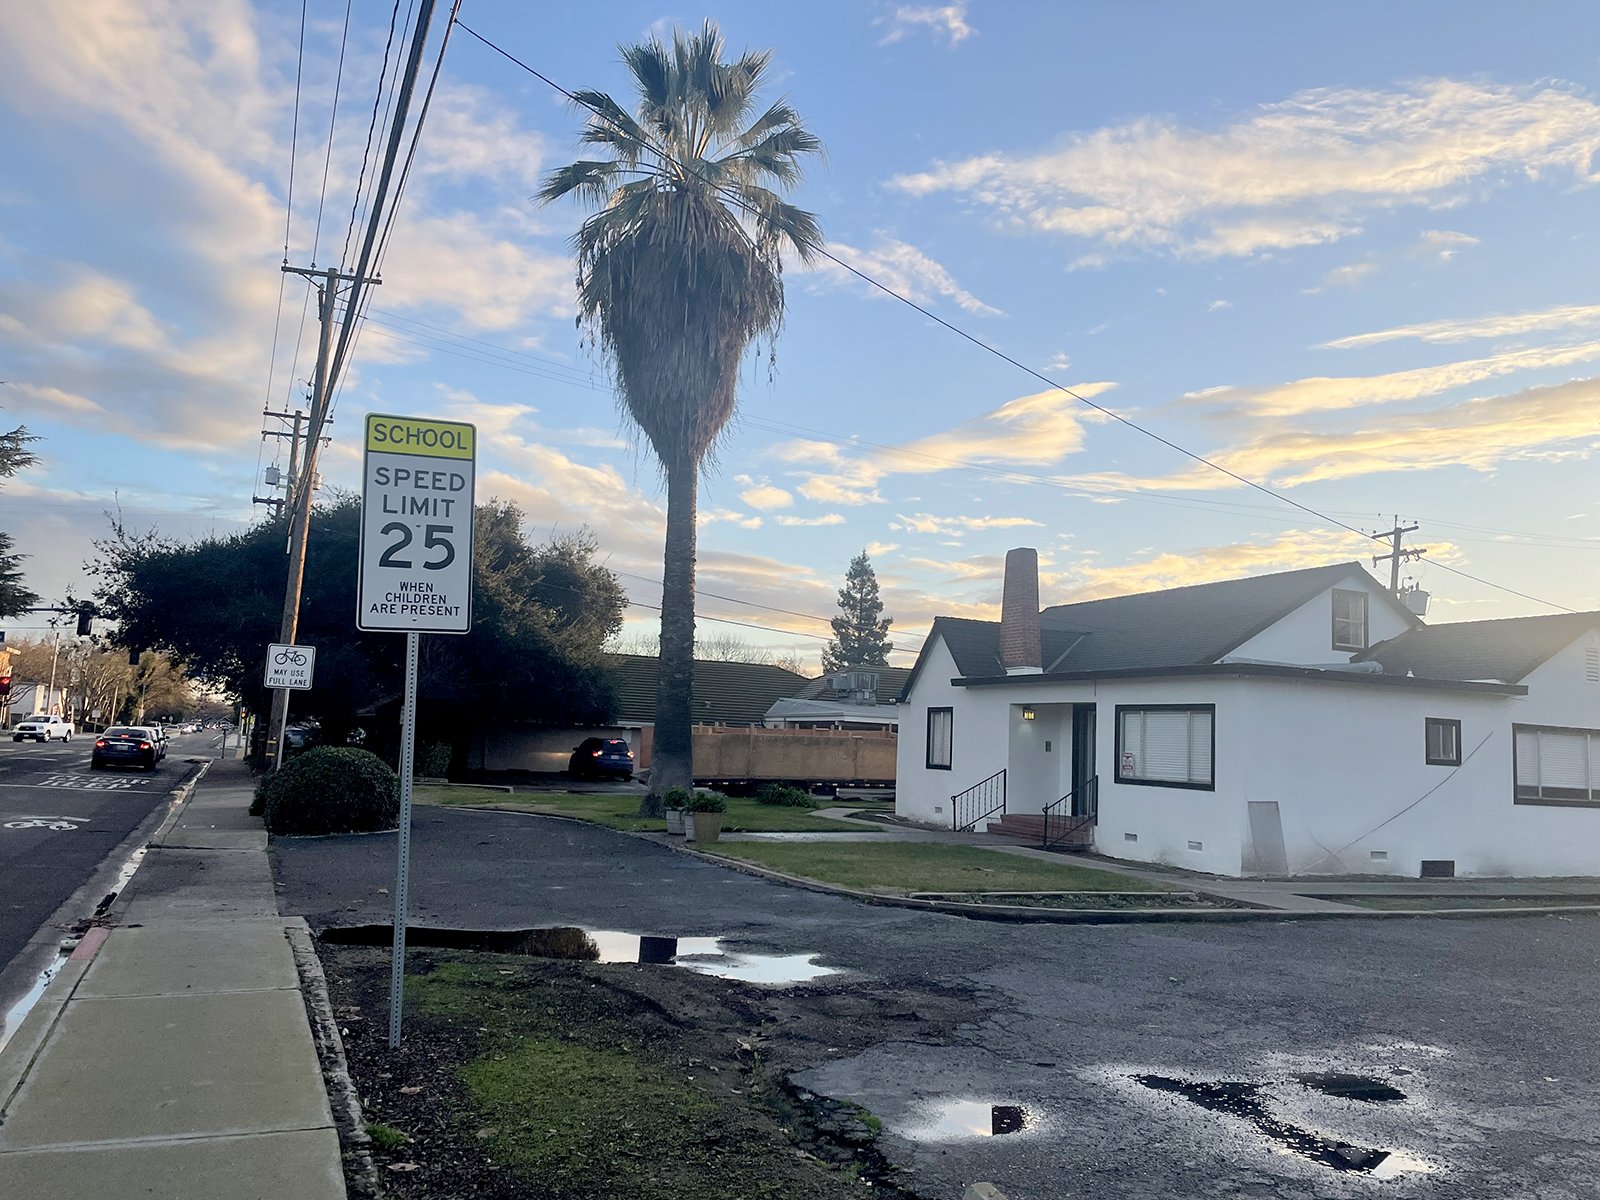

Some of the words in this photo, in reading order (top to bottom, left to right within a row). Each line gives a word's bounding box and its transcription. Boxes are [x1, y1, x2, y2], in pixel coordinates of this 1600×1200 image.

[373, 423, 468, 450] SCHOOL
[374, 466, 466, 492] SPEED
[382, 494, 455, 518] LIMIT
[378, 521, 456, 571] 25
[399, 581, 434, 593] WHEN
[385, 592, 447, 605] CHILDREN
[369, 603, 397, 615] ARE
[400, 604, 461, 617] PRESENT
[274, 668, 288, 676] MAY
[290, 669, 304, 677] USE
[268, 677, 286, 685] FULL
[289, 678, 307, 686] LANE
[37, 780, 132, 789] KEEP
